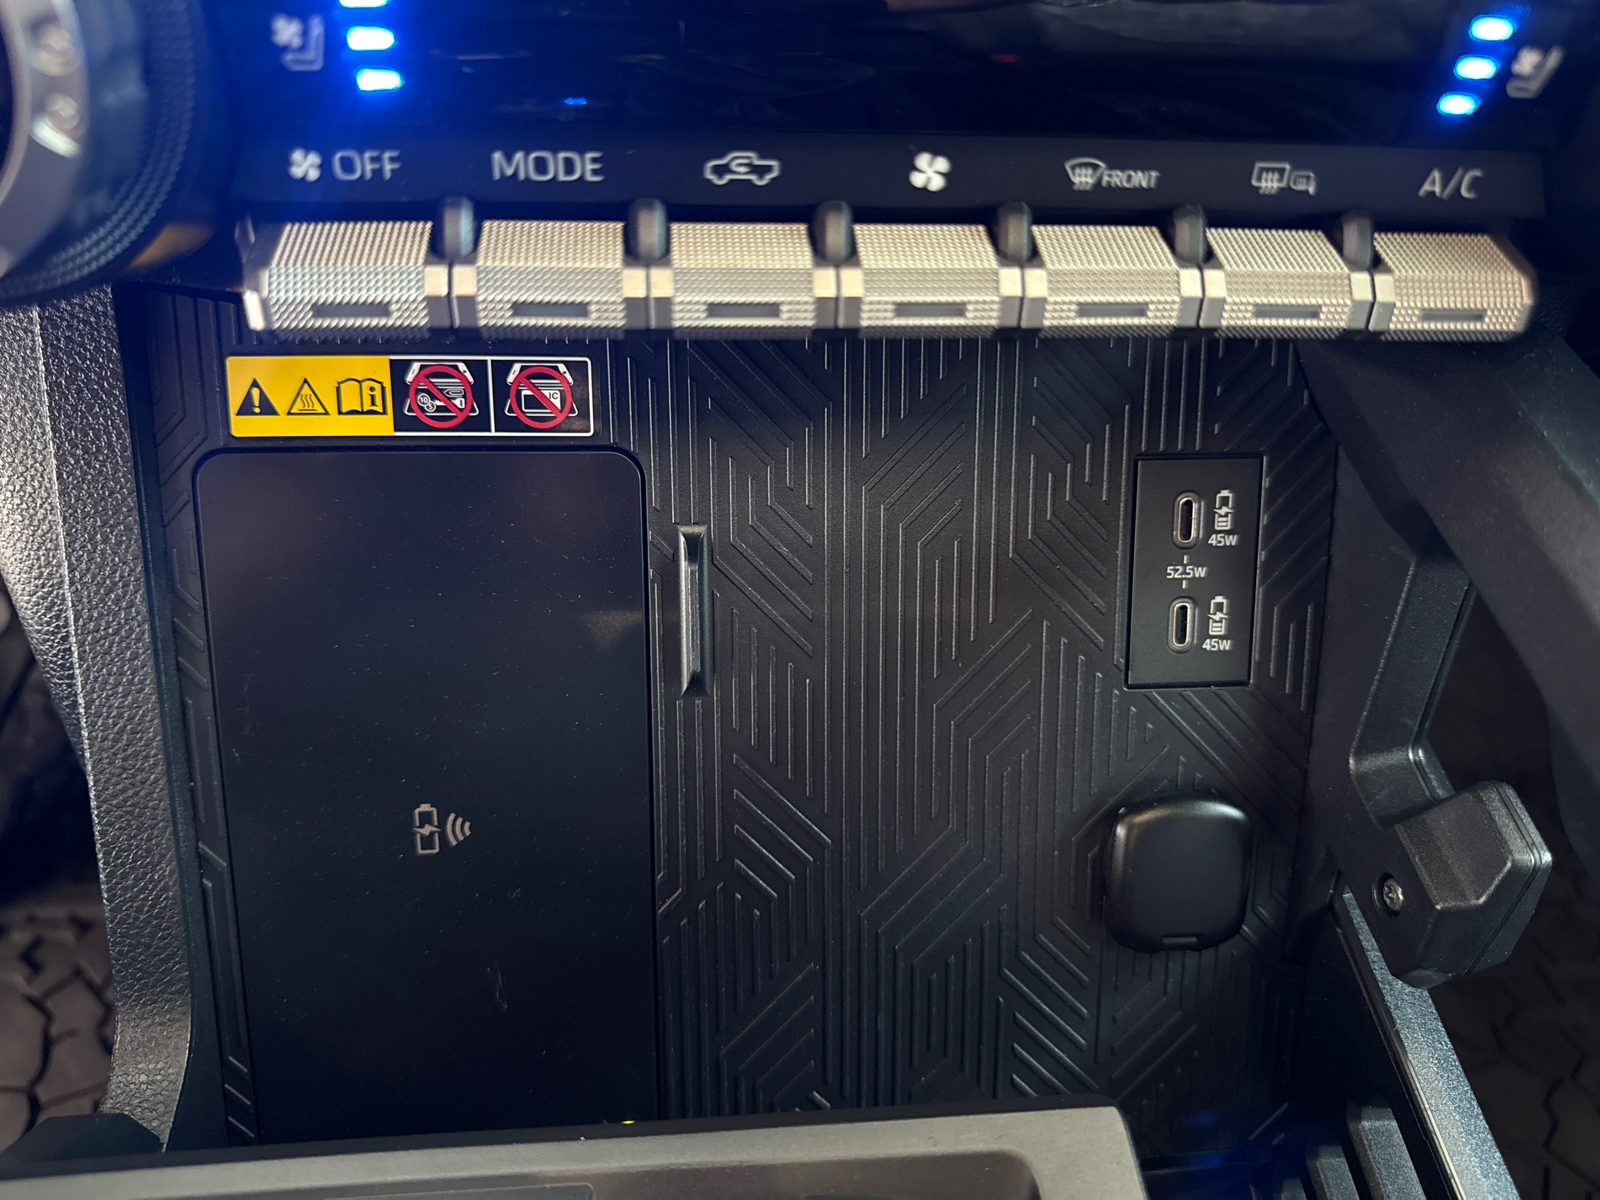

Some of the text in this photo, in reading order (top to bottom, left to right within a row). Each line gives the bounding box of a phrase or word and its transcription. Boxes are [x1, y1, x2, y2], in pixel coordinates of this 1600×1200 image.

[332, 149, 402, 182] OFF
[492, 151, 604, 181] MODE
[1101, 168, 1162, 190] FRONT
[1418, 167, 1485, 200] A/C
[549, 392, 559, 400] IC
[1208, 534, 1237, 546] 45W
[1166, 566, 1206, 579] 52.5W
[1202, 639, 1232, 651] 45W
